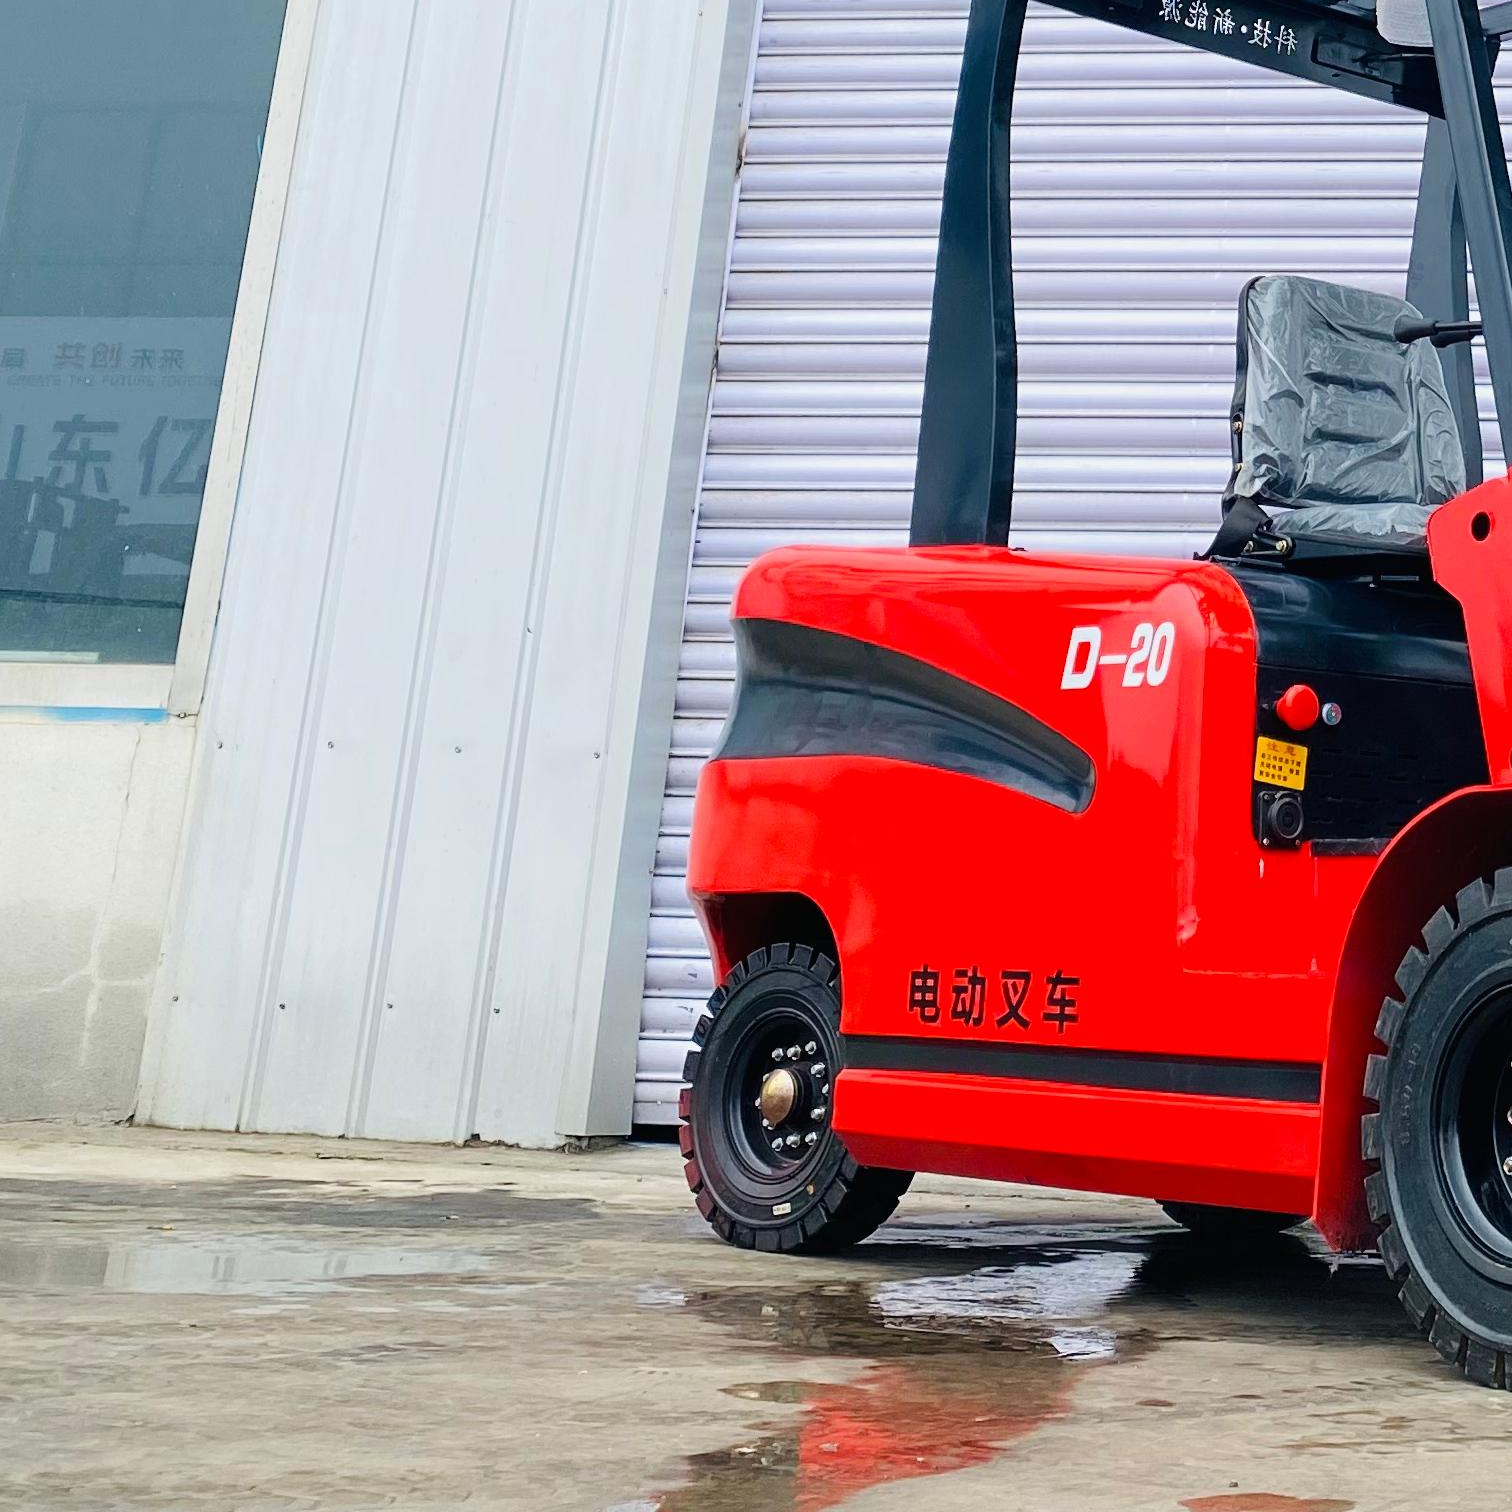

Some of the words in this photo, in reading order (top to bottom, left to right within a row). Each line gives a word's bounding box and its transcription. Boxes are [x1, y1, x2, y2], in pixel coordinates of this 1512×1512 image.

[54, 341, 184, 369] 共创未来
[1060, 621, 1176, 690] D-20
[908, 963, 1081, 1034] 电动叉车
